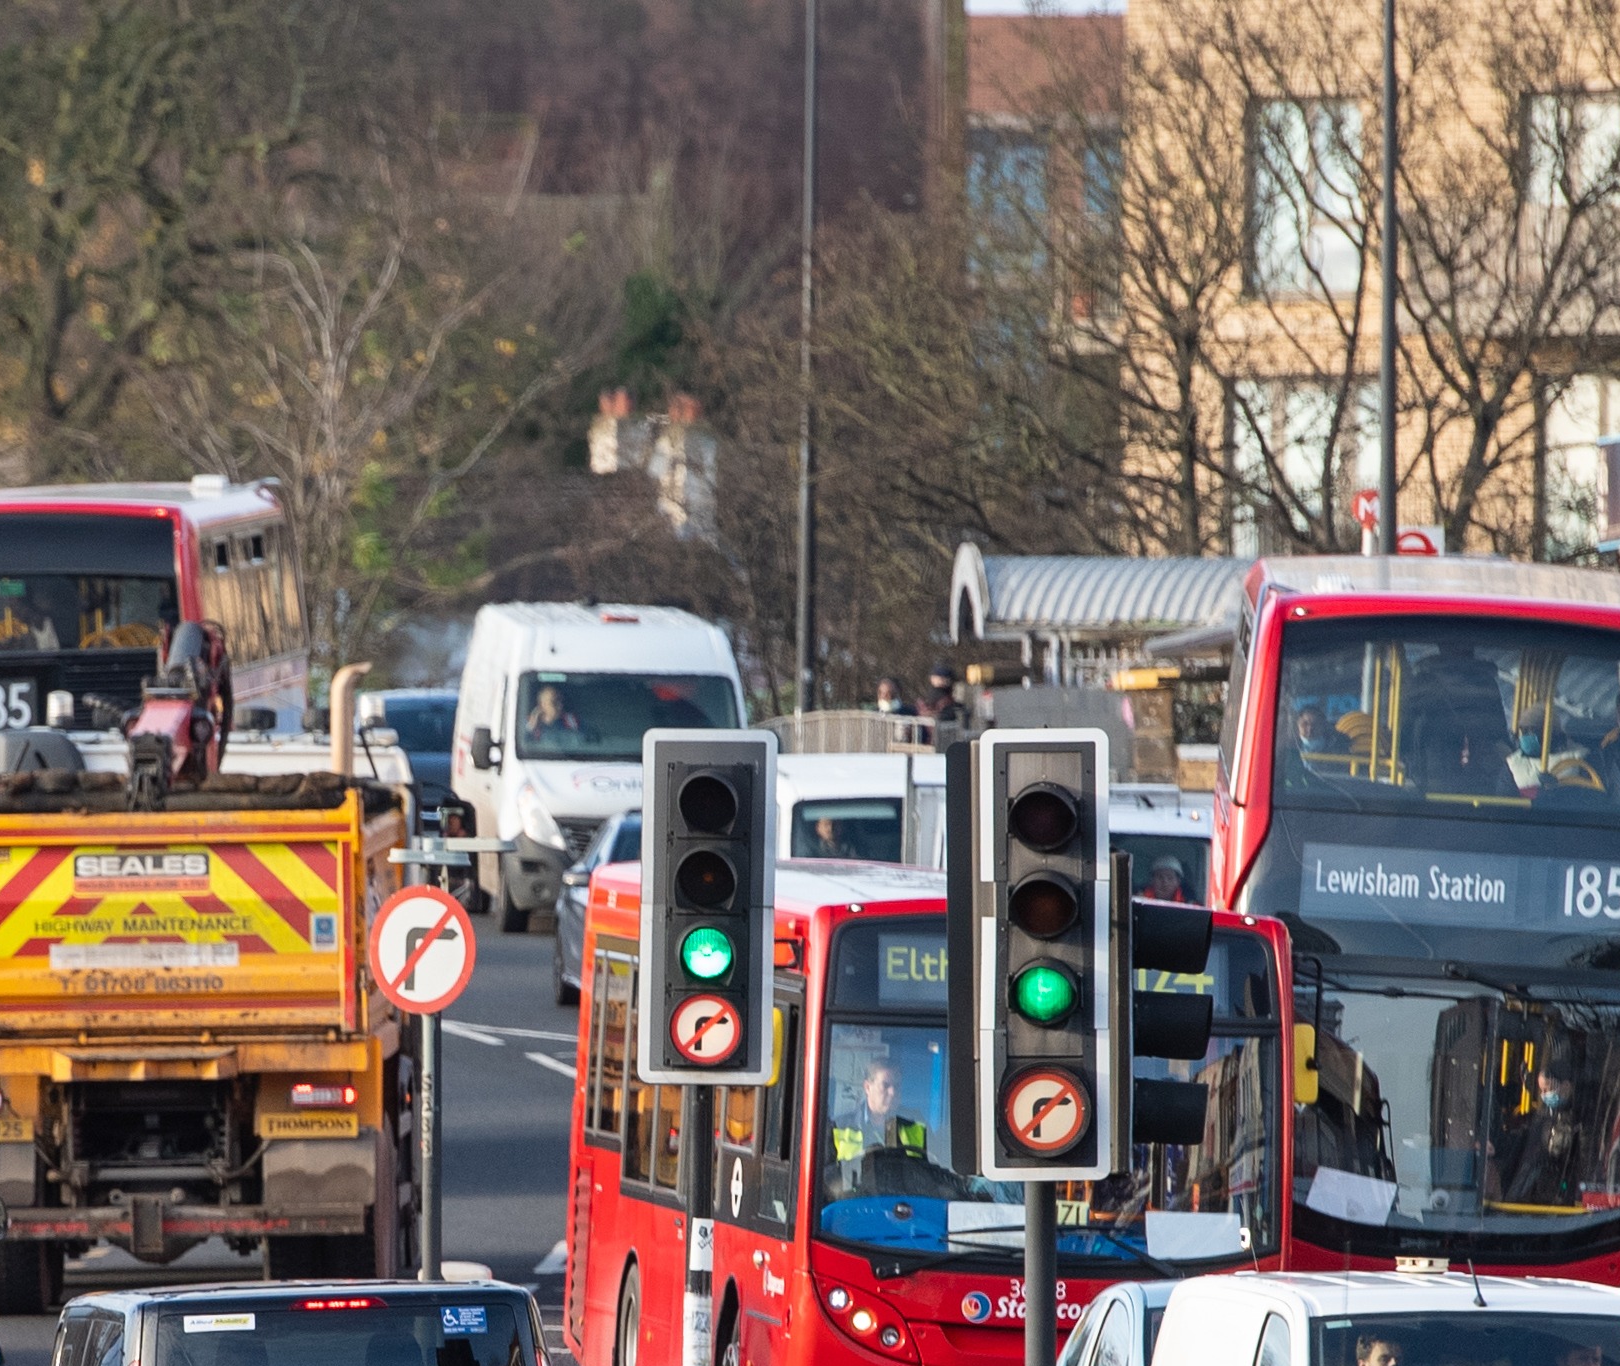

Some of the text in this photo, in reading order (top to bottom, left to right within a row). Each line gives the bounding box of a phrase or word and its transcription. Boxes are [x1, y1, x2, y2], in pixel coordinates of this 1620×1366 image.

[75, 854, 208, 876] SEALES
[1316, 859, 1506, 904] Lewisham Station
[34, 915, 253, 933] HIGHWAY MAINTENANCE
[887, 947, 948, 982] Elth
[266, 1117, 353, 1133] THOMPSONS
